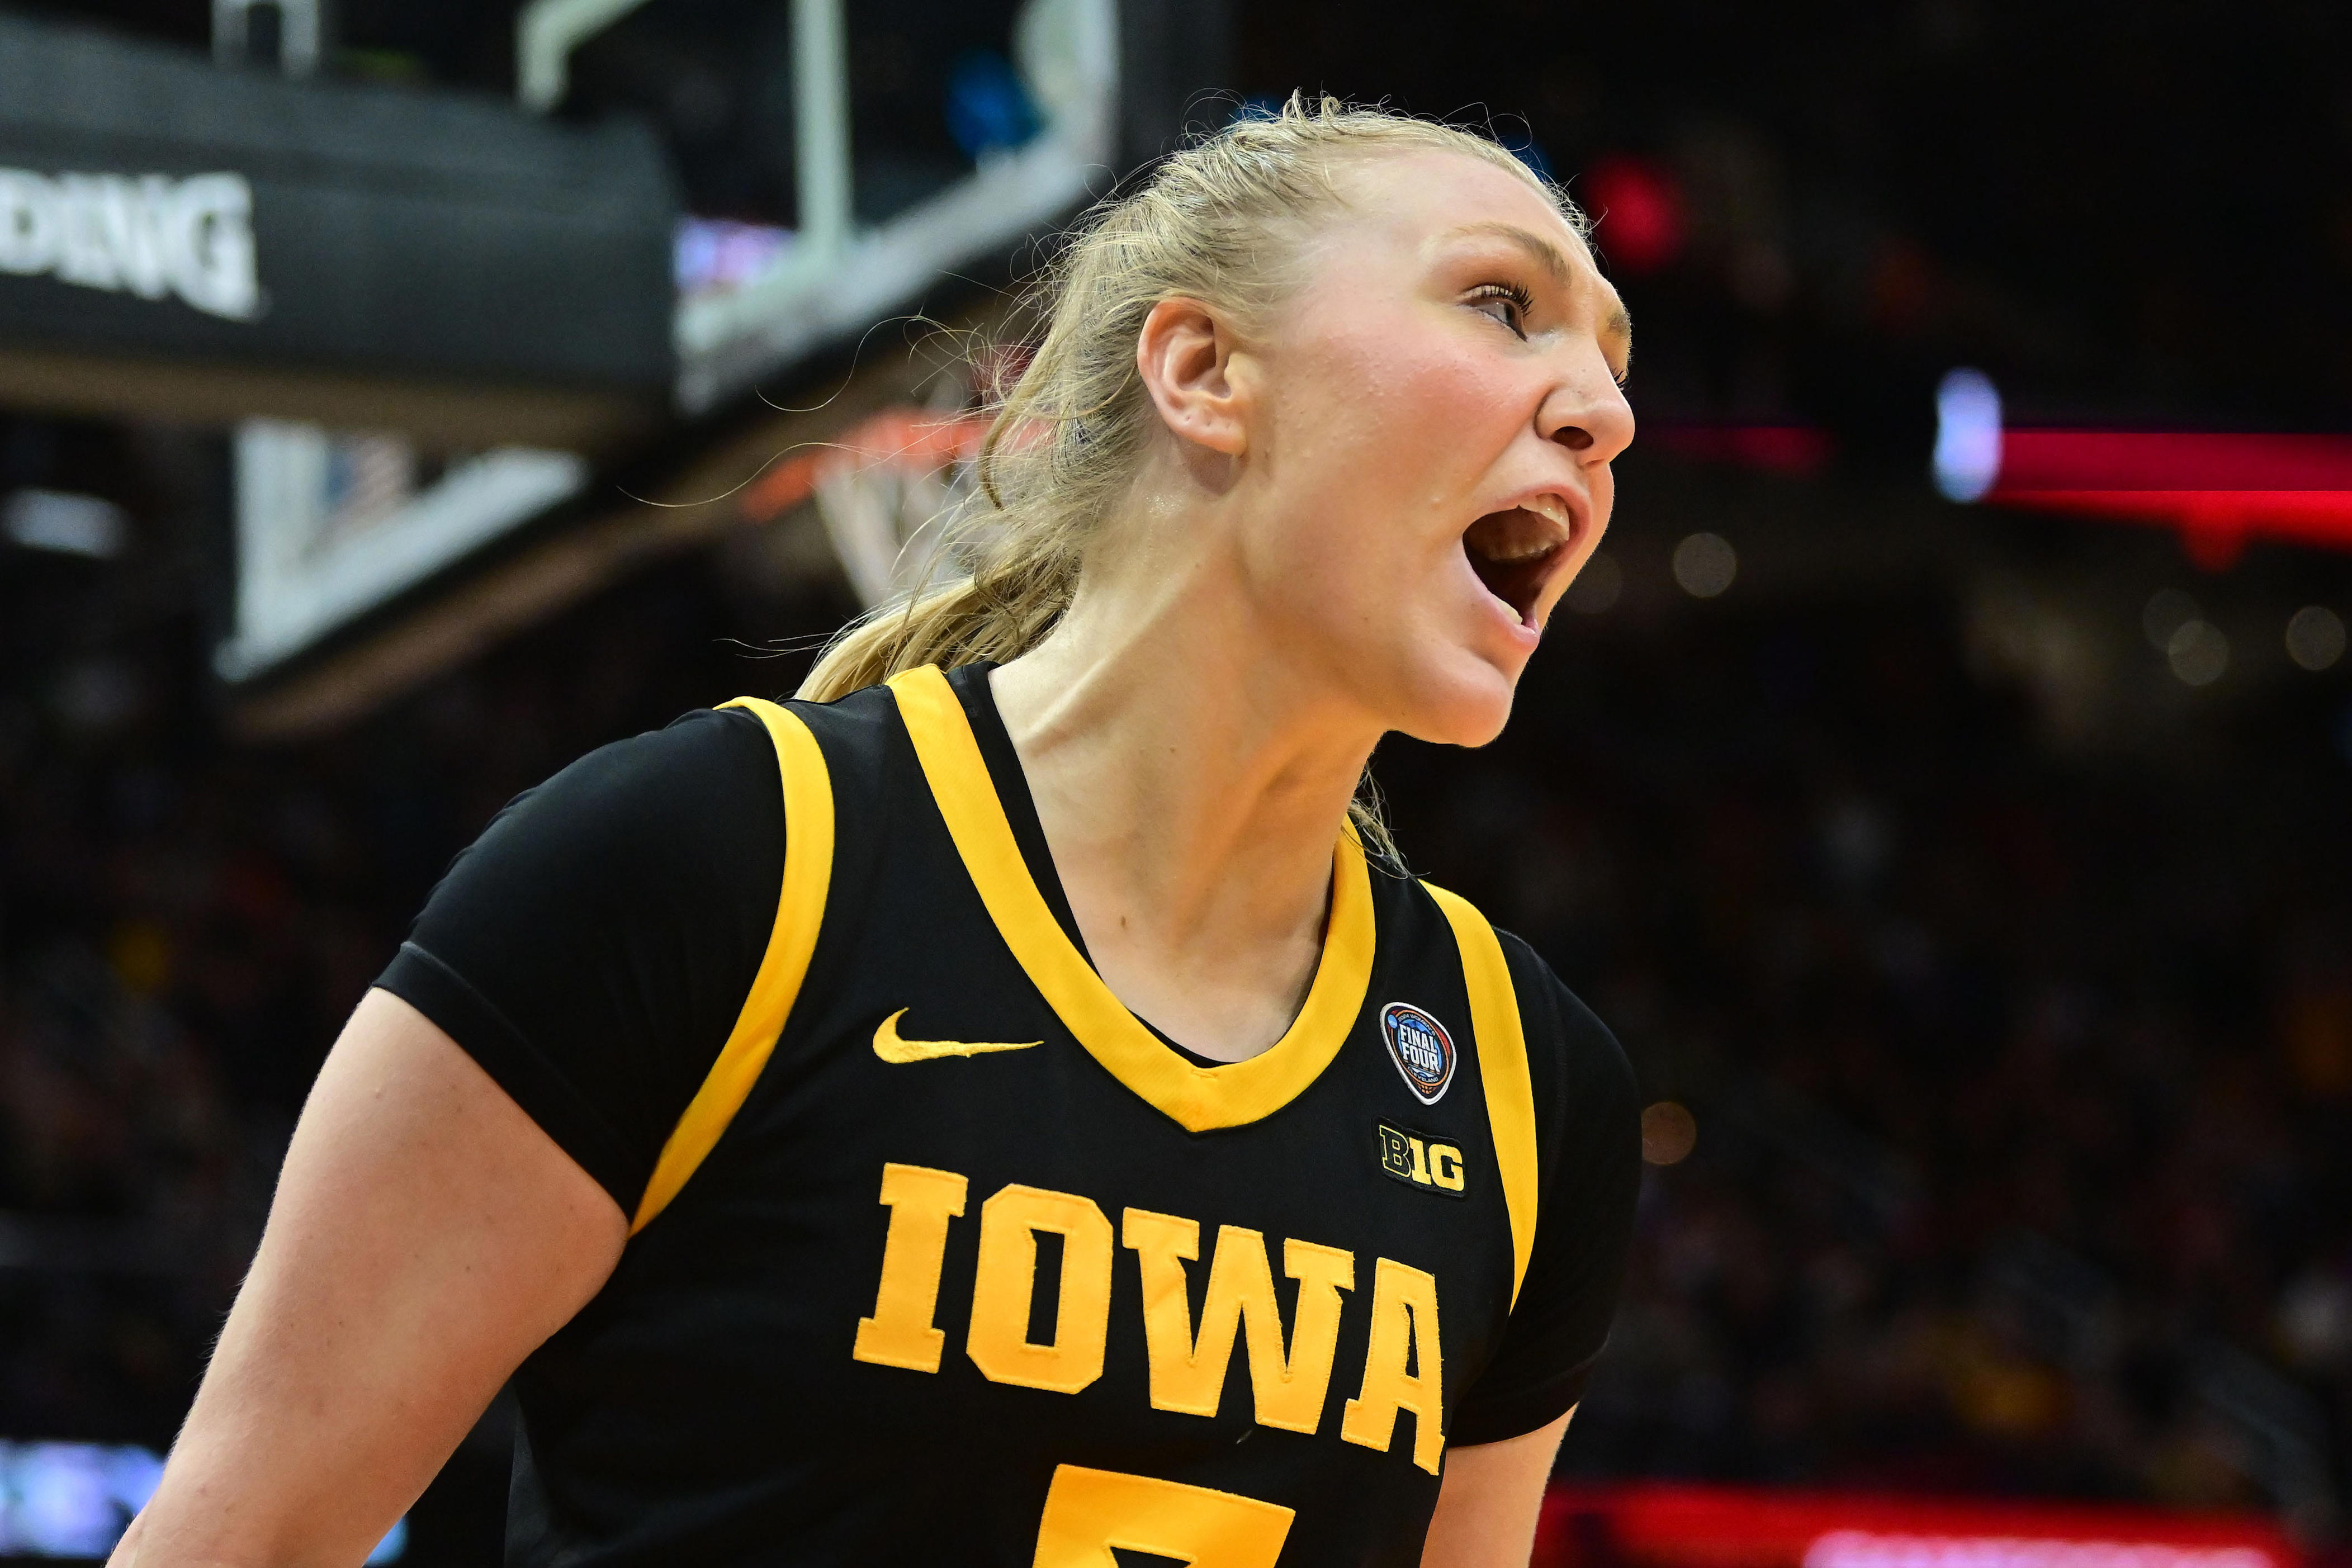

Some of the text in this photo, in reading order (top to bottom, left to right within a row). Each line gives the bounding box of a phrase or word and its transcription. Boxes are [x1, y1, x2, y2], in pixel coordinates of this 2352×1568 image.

[1399, 1024, 1438, 1053] FINAL
[1401, 1041, 1441, 1073] FOUR
[1408, 1067, 1438, 1083] CLEVELAND
[853, 1162, 1445, 1476] IOWA
